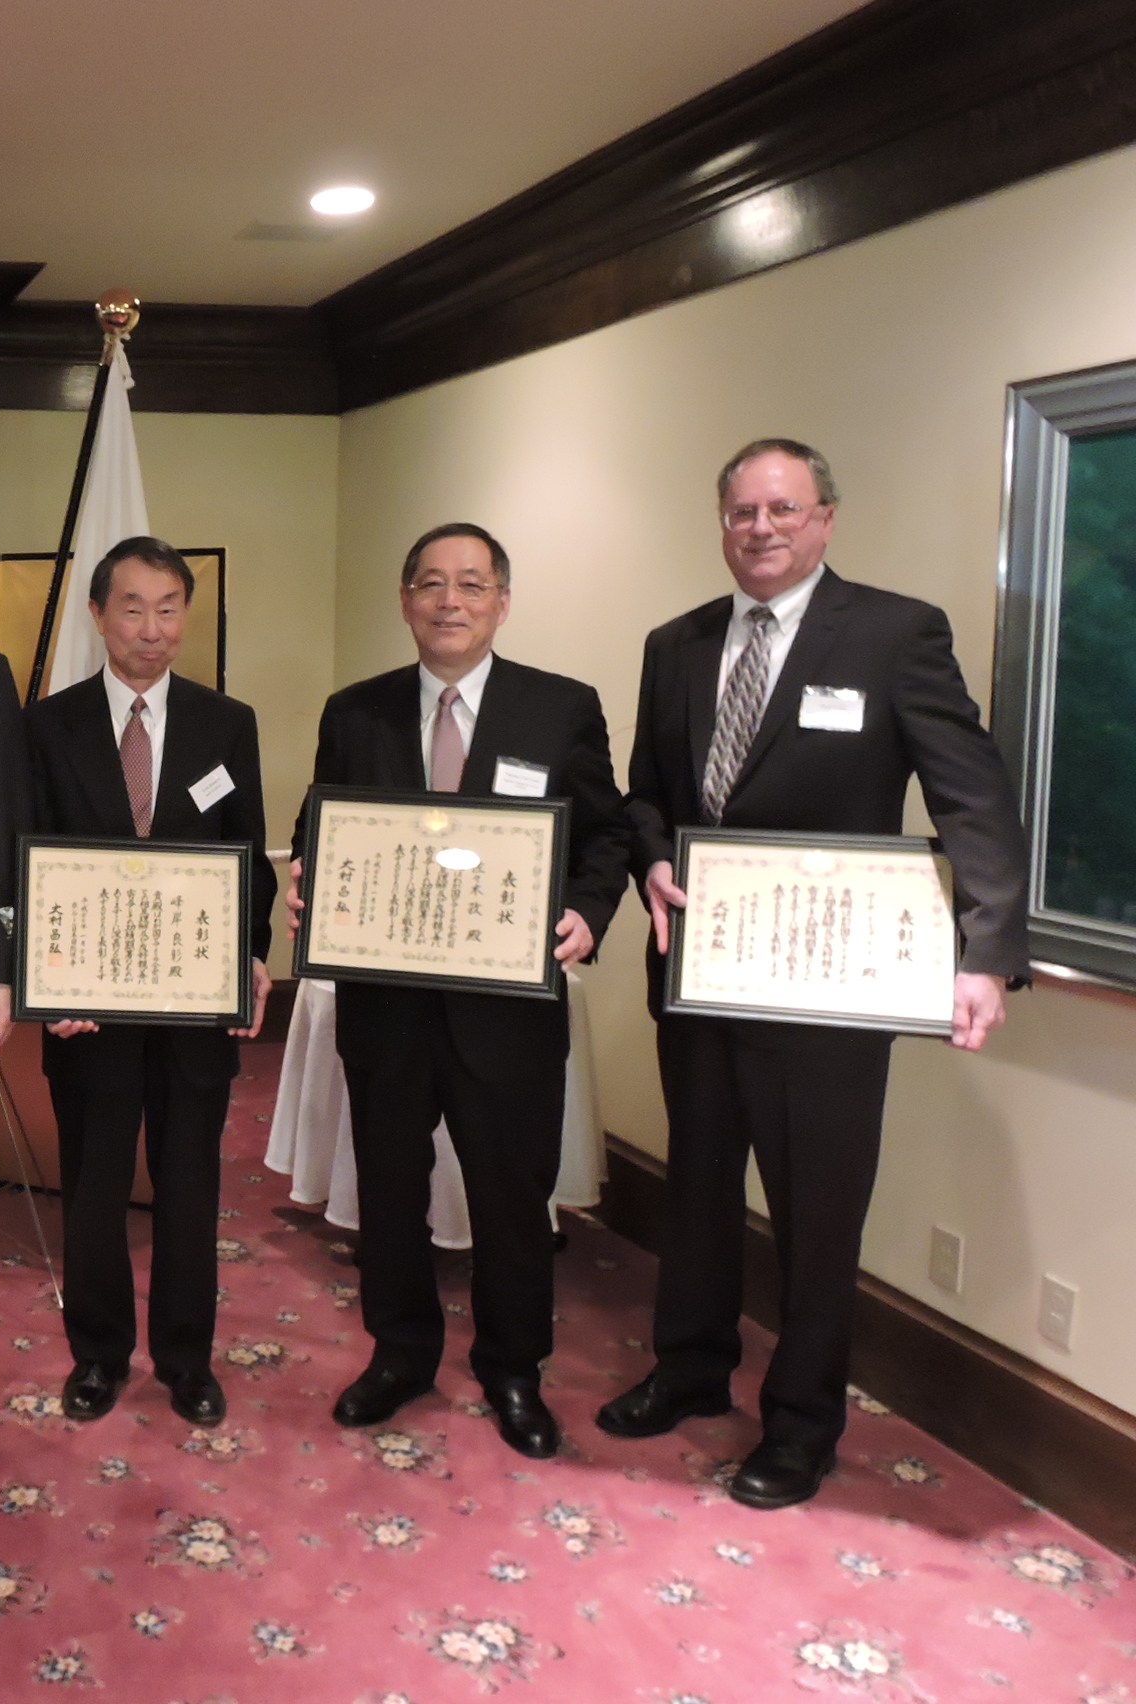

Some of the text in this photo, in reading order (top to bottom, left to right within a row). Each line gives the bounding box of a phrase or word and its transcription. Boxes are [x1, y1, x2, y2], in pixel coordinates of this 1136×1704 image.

[497, 870, 516, 924] 表彰状
[194, 909, 209, 959] 表彰状
